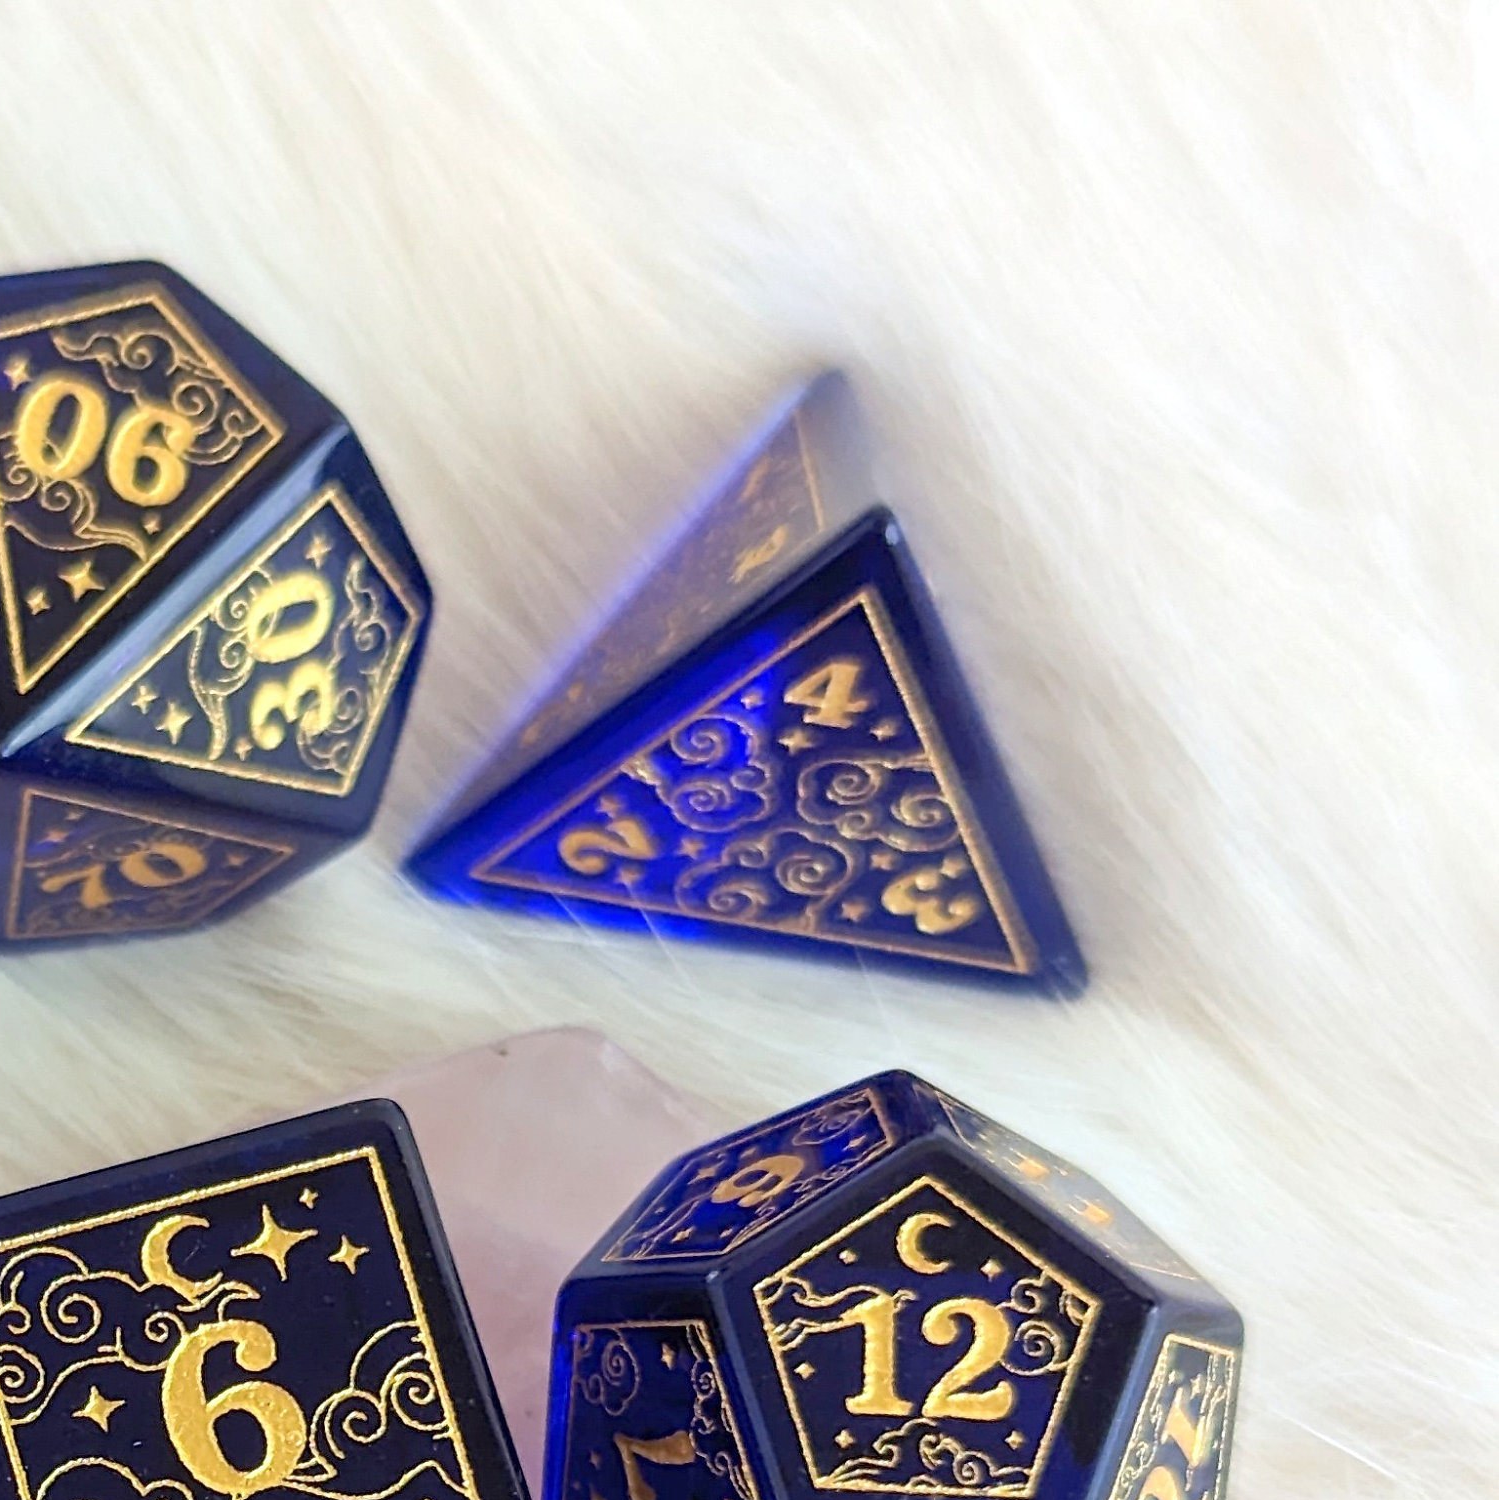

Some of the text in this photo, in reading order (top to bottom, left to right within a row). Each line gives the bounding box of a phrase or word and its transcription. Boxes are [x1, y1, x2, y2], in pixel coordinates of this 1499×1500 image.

[248, 572, 334, 751] 30
[784, 661, 869, 729] 4
[42, 843, 207, 910] 70
[558, 818, 658, 874] 2
[881, 869, 976, 935] 3
[846, 1296, 1015, 1420] 12
[162, 1319, 309, 1495] 6
